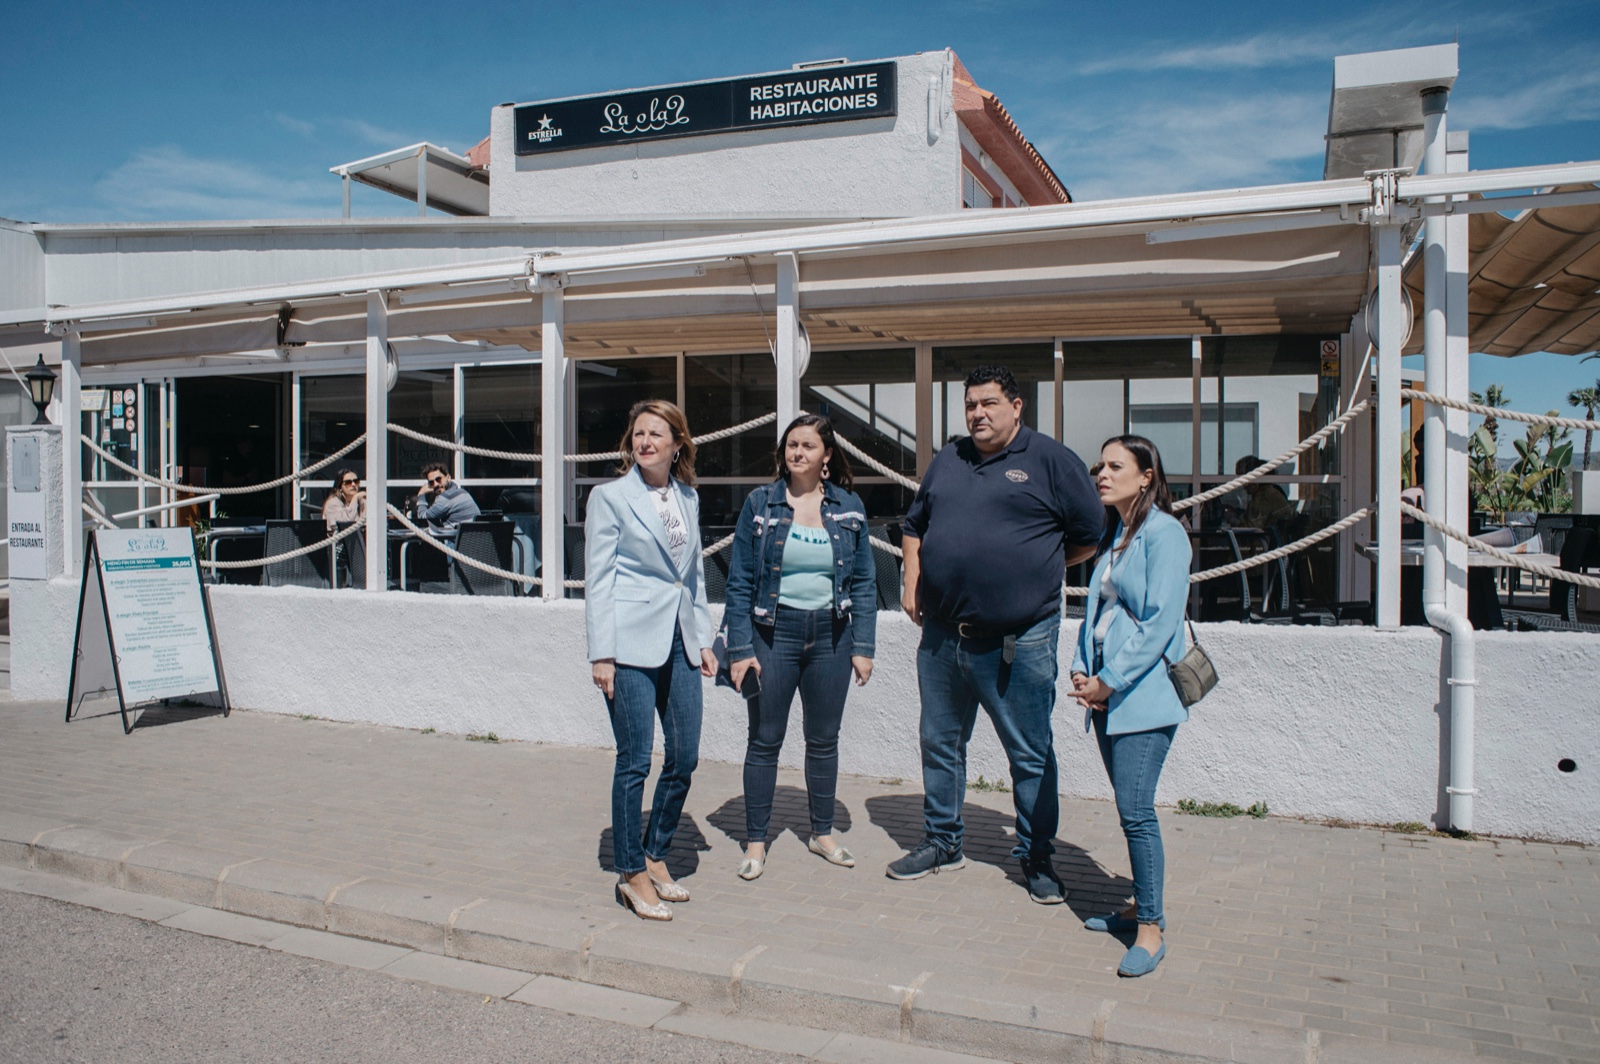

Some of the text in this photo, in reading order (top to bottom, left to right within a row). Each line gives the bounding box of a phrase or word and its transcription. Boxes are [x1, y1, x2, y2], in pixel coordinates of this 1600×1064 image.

[750, 73, 878, 101] RESTAURANTE
[750, 93, 878, 120] HABITACIONES
[600, 103, 629, 133] La
[528, 128, 563, 140] ESTRELLA
[11, 523, 42, 533] ENTRADA AL
[9, 538, 44, 548] RESTAURANTE
